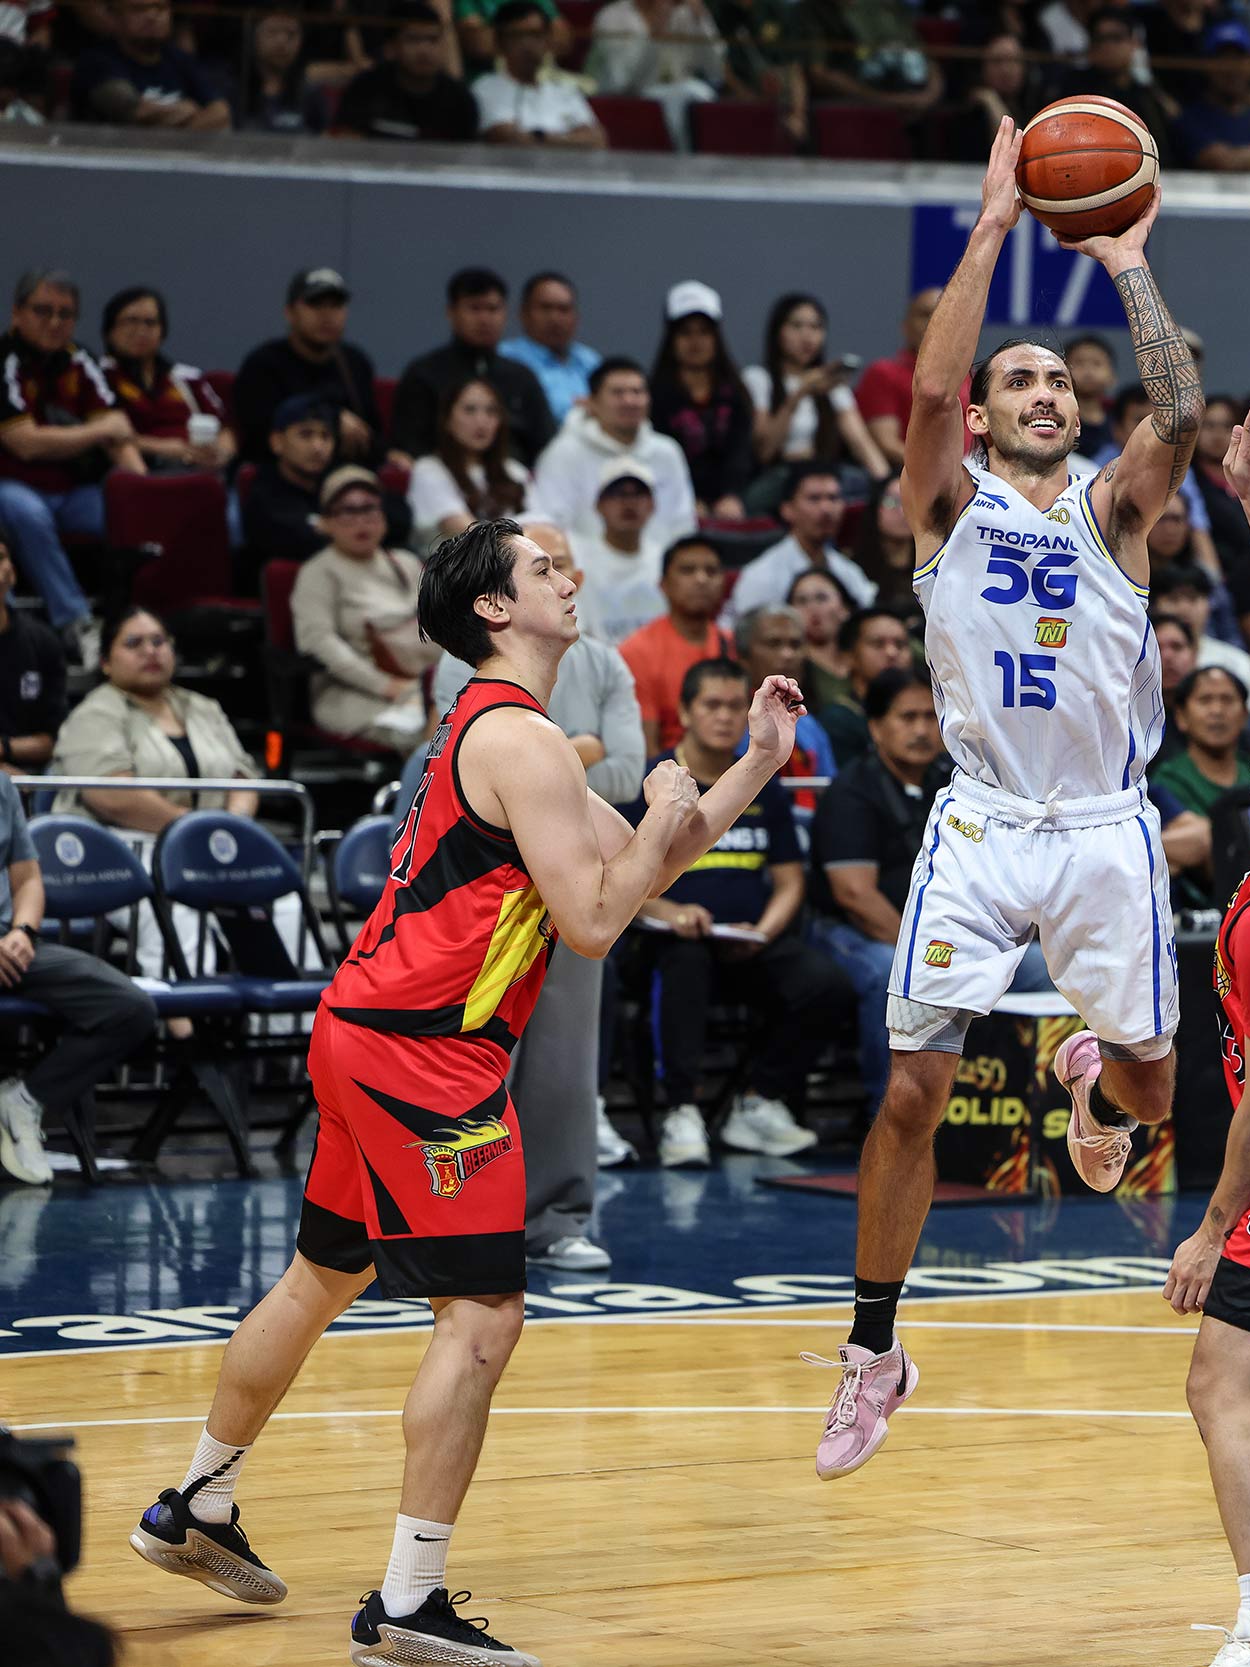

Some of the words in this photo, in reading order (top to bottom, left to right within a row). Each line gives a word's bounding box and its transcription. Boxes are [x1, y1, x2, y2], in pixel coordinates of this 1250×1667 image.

[973, 498, 996, 511] ANTA
[979, 543, 1080, 610] 5G
[1033, 620, 1072, 645] TNT
[994, 650, 1057, 711] 15
[945, 813, 985, 844] PBA50
[922, 944, 959, 964] TNT
[946, 1096, 1026, 1126] OLID
[462, 1136, 513, 1179] BEERMEN
